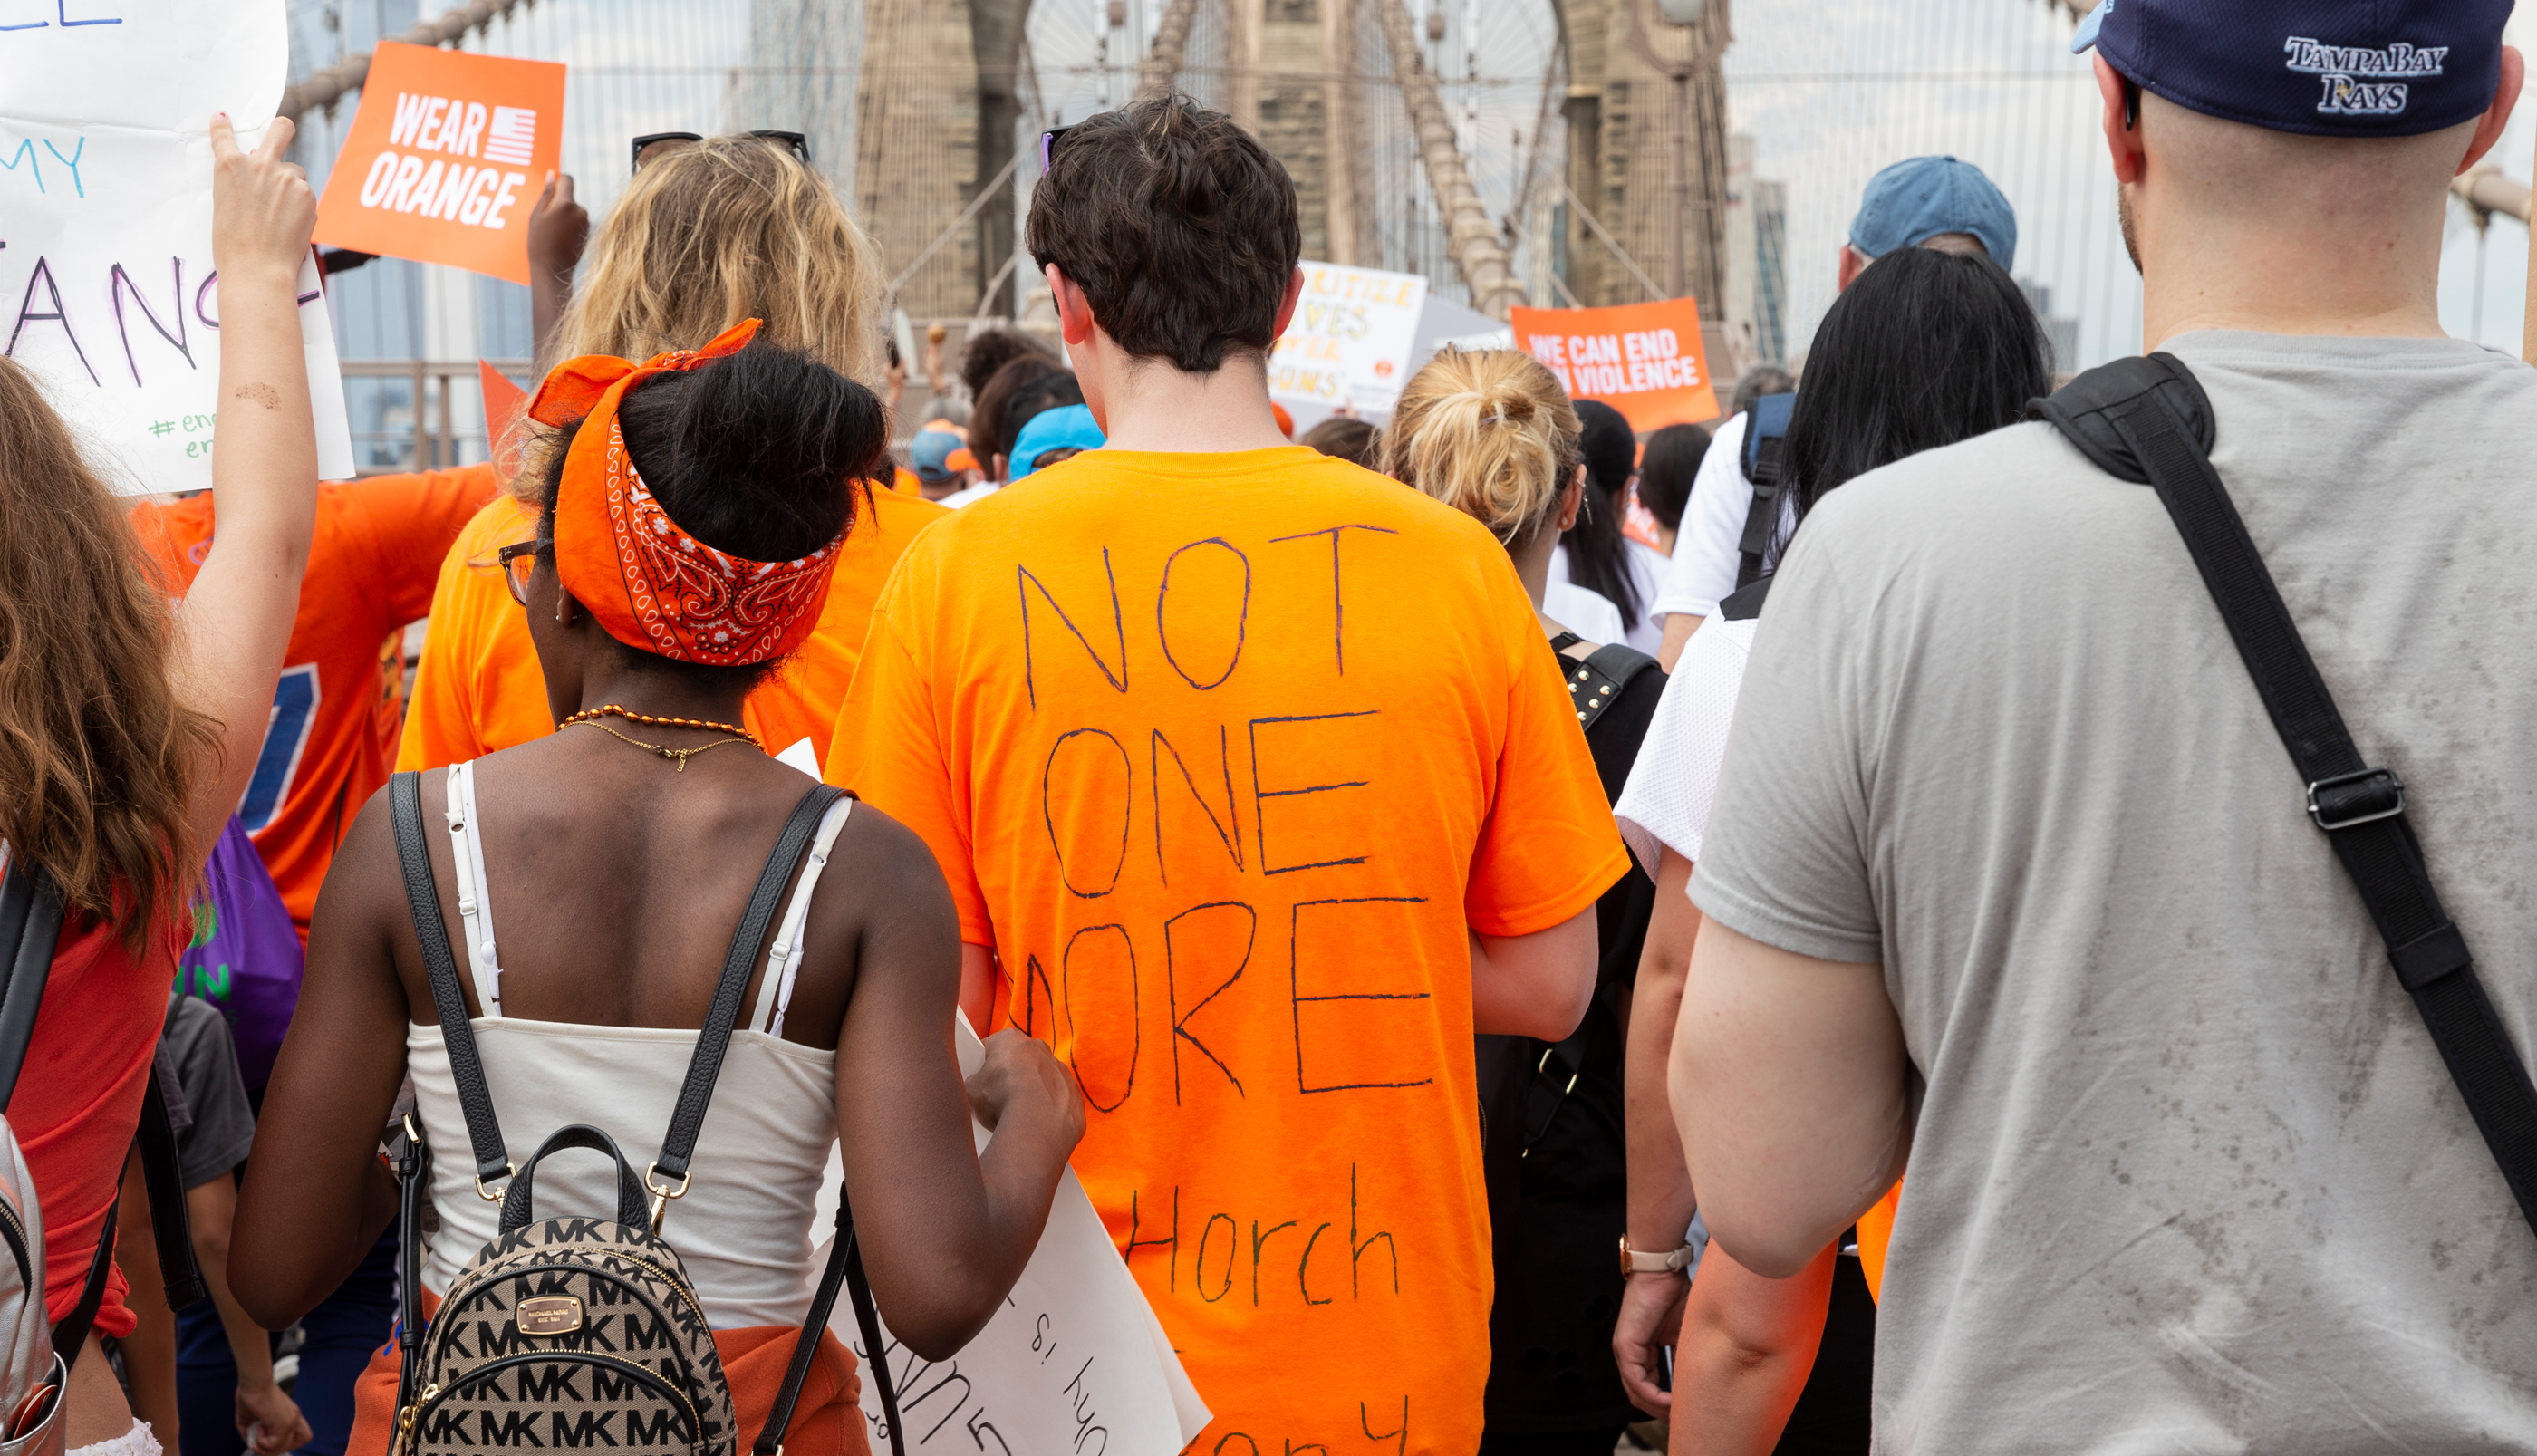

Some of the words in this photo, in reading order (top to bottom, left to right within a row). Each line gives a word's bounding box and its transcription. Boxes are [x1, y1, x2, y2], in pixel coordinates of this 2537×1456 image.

[2317, 74, 2408, 114] RAYS
[390, 92, 487, 158] WEAR
[360, 150, 527, 230] ORANGE
[1304, 269, 1416, 307] RITIZE
[1529, 333, 1568, 366] WE
[1568, 334, 1622, 366] CAN
[1623, 328, 1679, 363] END
[1572, 355, 1701, 397] VIOLENCE
[1018, 524, 1399, 714] NOT
[1044, 710, 1383, 898] ONE
[545, 1220, 606, 1245] MK
[518, 1364, 584, 1402] MK
[481, 1410, 546, 1447] MK
[552, 1410, 619, 1447] MK
[626, 1409, 691, 1447] MK
